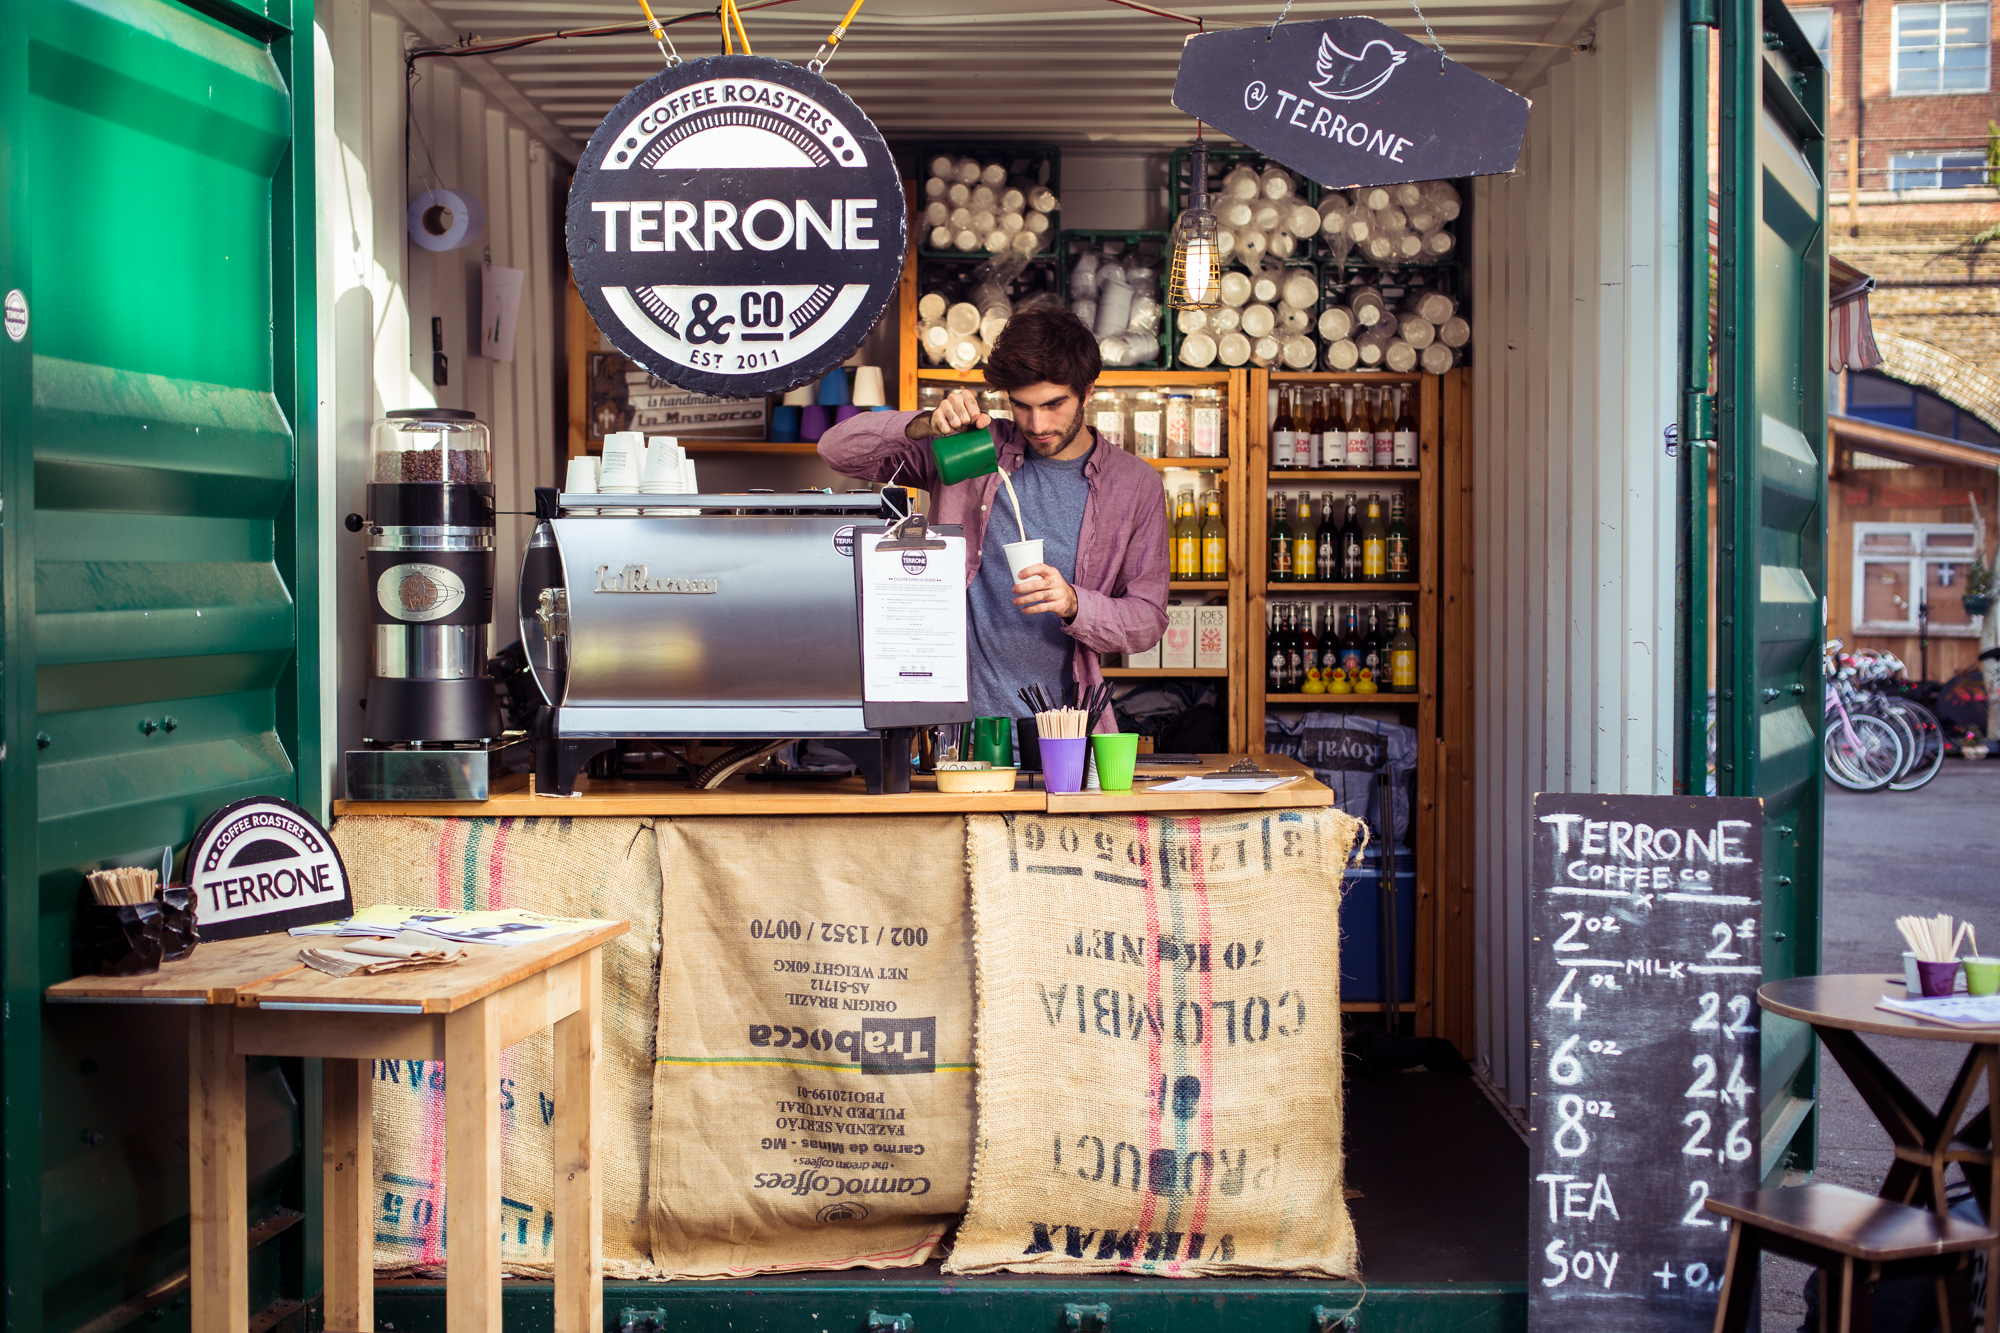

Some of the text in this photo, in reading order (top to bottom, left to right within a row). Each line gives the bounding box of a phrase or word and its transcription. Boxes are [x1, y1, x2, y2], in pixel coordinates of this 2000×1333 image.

[640, 84, 834, 136] COFFEE ROASTERS
[1244, 80, 1414, 164] @ TERRONE
[591, 199, 880, 252] TERRONE
[685, 291, 784, 345] & CO
[737, 349, 781, 370] 2011
[1348, 438, 1368, 446] JOHN
[217, 814, 306, 850] COFFEE ROASTERS
[1539, 813, 1753, 865] TERRONE
[1567, 861, 1671, 889] COFFEE
[203, 863, 335, 912] TERRONE
[750, 919, 802, 940] 0070
[821, 922, 869, 945] 1352
[890, 926, 928, 947] 002
[773, 959, 909, 980] NET WEIGHT 60KG
[1626, 959, 1687, 978] MILK
[810, 978, 871, 994] AS-51712
[785, 993, 898, 1012] ORIGIN BRAZIL
[1038, 982, 1307, 1046] COLOMBIA
[749, 1023, 930, 1062] Trabocca
[776, 1101, 906, 1120] PULPED NATURAL
[776, 1117, 906, 1136] FAZENDA SERTÃO
[760, 1136, 787, 1150] MG
[801, 1138, 845, 1154] Minas
[849, 1142, 869, 1153] de
[873, 1142, 925, 1155] Carmo
[799, 1156, 889, 1171] the dream coffees
[1052, 1131, 1281, 1197] PRODUCT
[754, 1172, 931, 1197] CarmoCoffees
[1536, 1173, 1620, 1223] TEA
